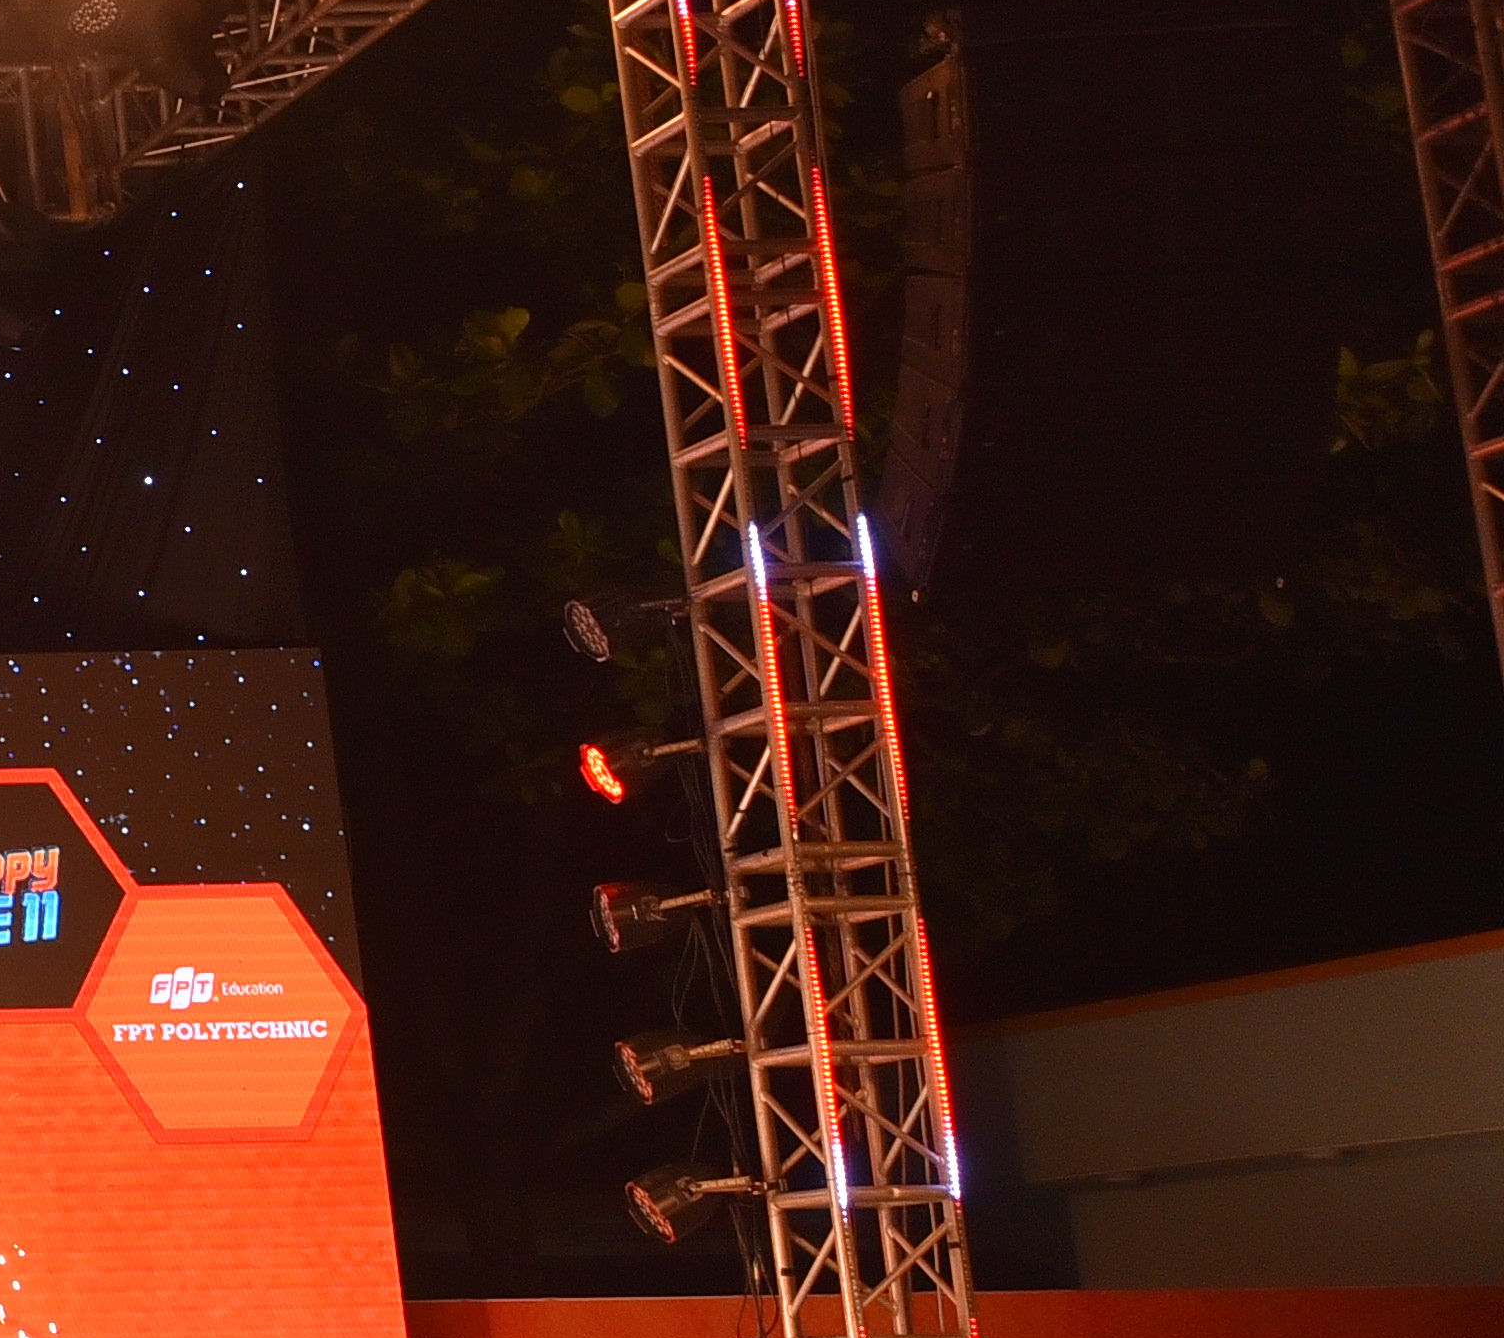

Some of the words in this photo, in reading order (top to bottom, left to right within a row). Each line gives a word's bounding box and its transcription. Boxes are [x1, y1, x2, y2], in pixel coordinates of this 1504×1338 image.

[221, 980, 284, 997] Education
[112, 1023, 156, 1042] FPT
[161, 1019, 328, 1041] POLYTECHNIC
